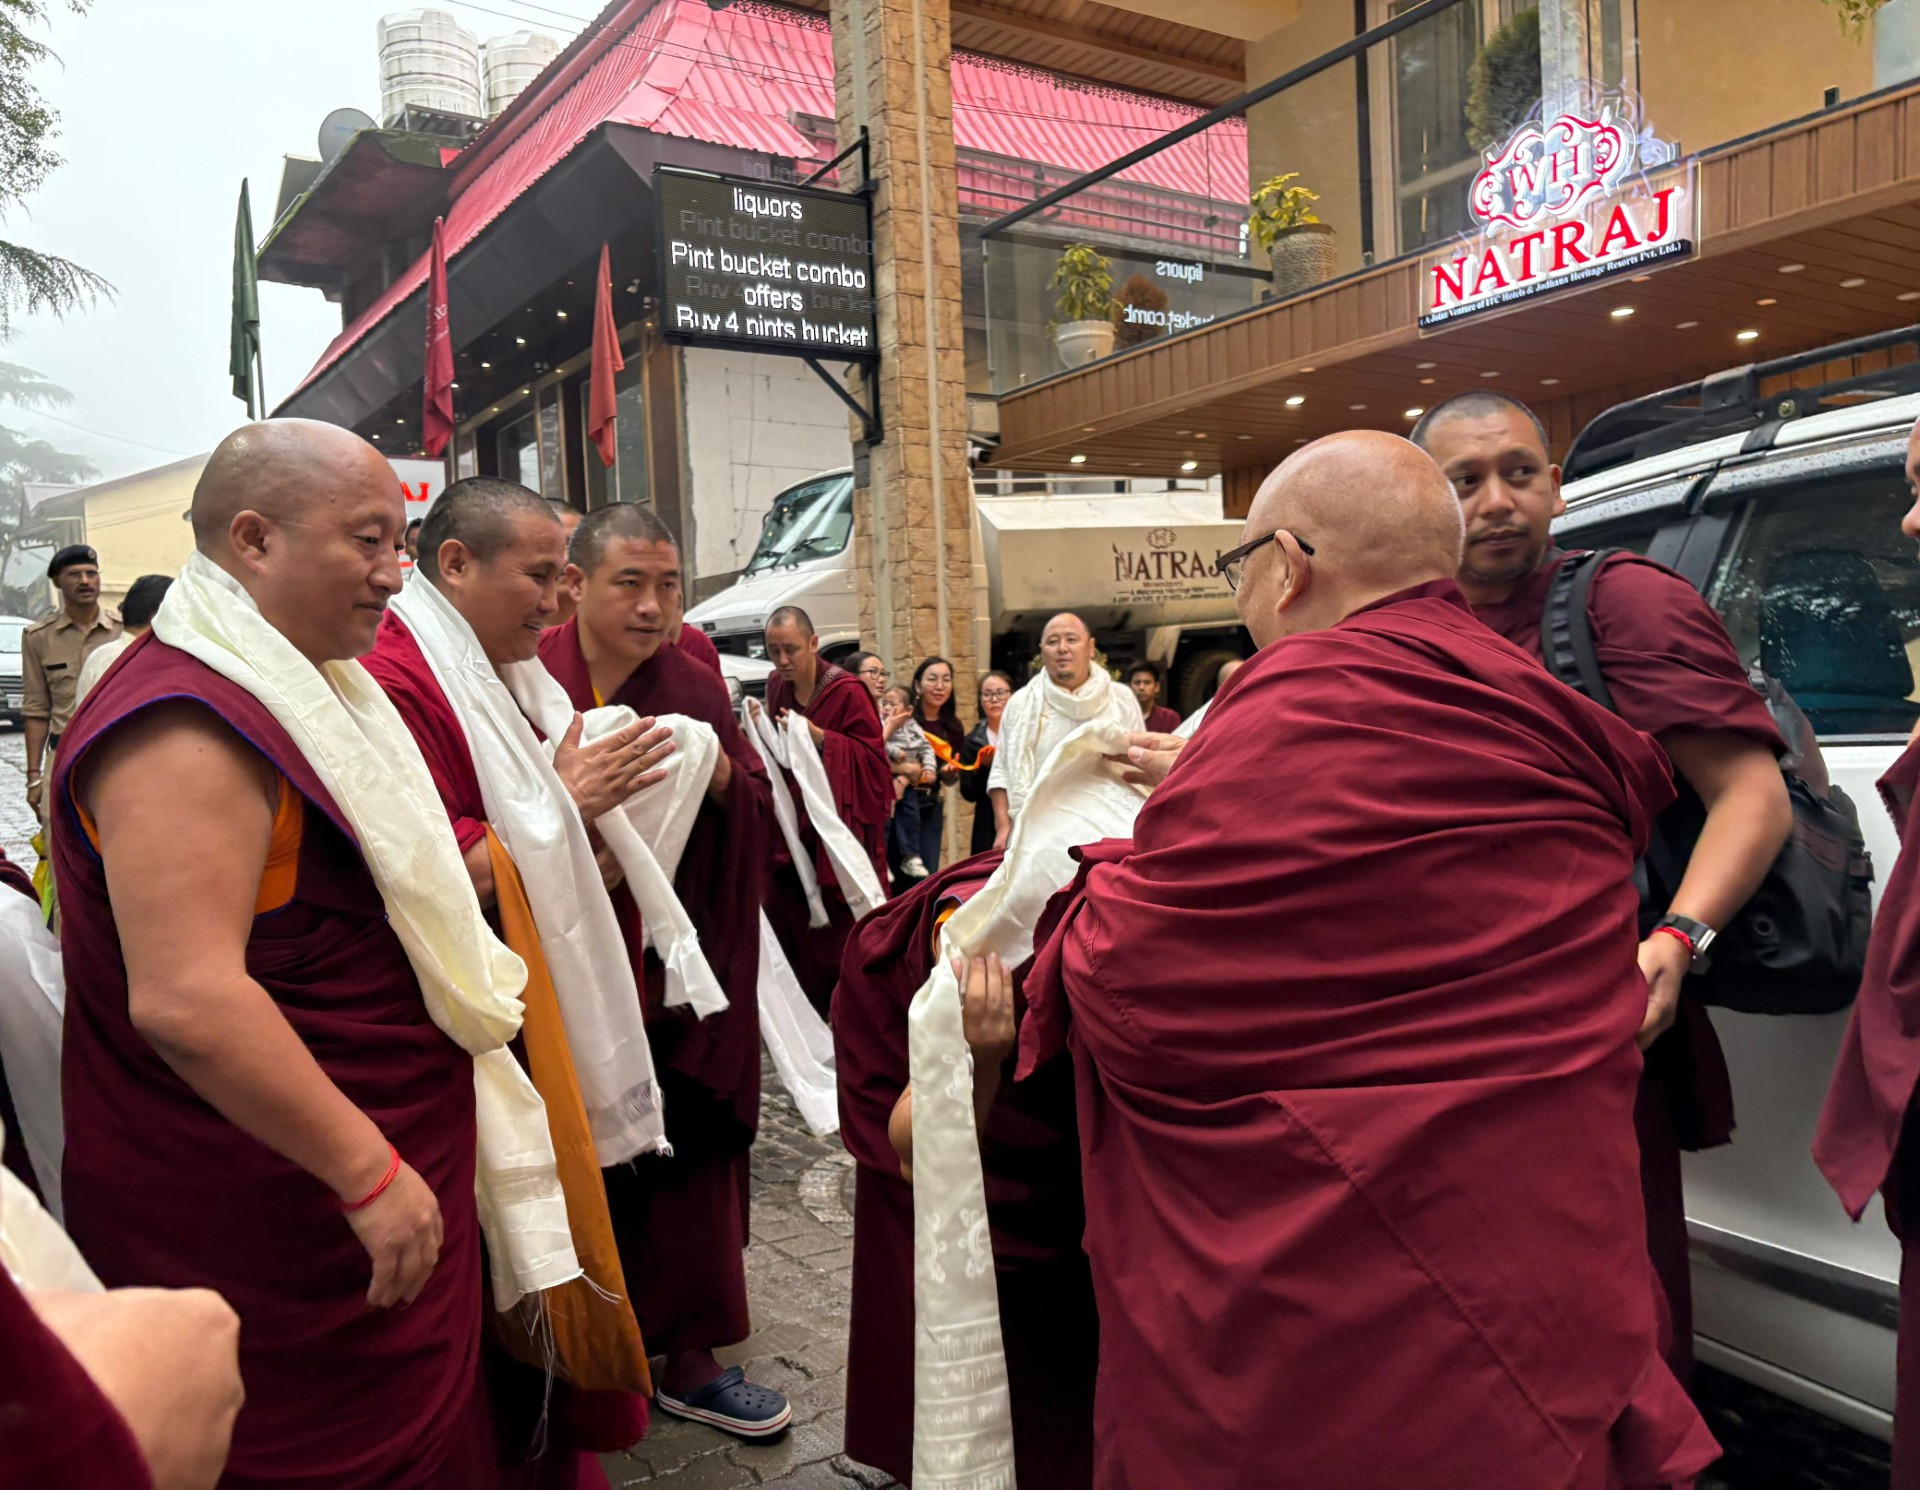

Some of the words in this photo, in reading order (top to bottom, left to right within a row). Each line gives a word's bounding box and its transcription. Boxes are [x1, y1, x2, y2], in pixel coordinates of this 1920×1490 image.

[732, 187, 804, 221] liquors
[670, 241, 716, 271] Pint
[719, 247, 793, 280] bucket
[796, 262, 866, 290] combo
[1430, 185, 1683, 311] NATRAJ
[743, 282, 804, 312] offers
[1449, 304, 1477, 318] Venture
[1485, 295, 1502, 307] ITC
[1502, 289, 1526, 302] Hotels
[1526, 286, 1535, 295] &
[1535, 276, 1569, 293] Jodhana
[1570, 264, 1606, 282] Heritage
[1606, 255, 1639, 271] Resorts
[1639, 250, 1658, 262] Pvt.
[1659, 241, 1682, 256] Ltd.)
[725, 311, 740, 333] 4
[1112, 544, 1223, 582] NATRAJ
